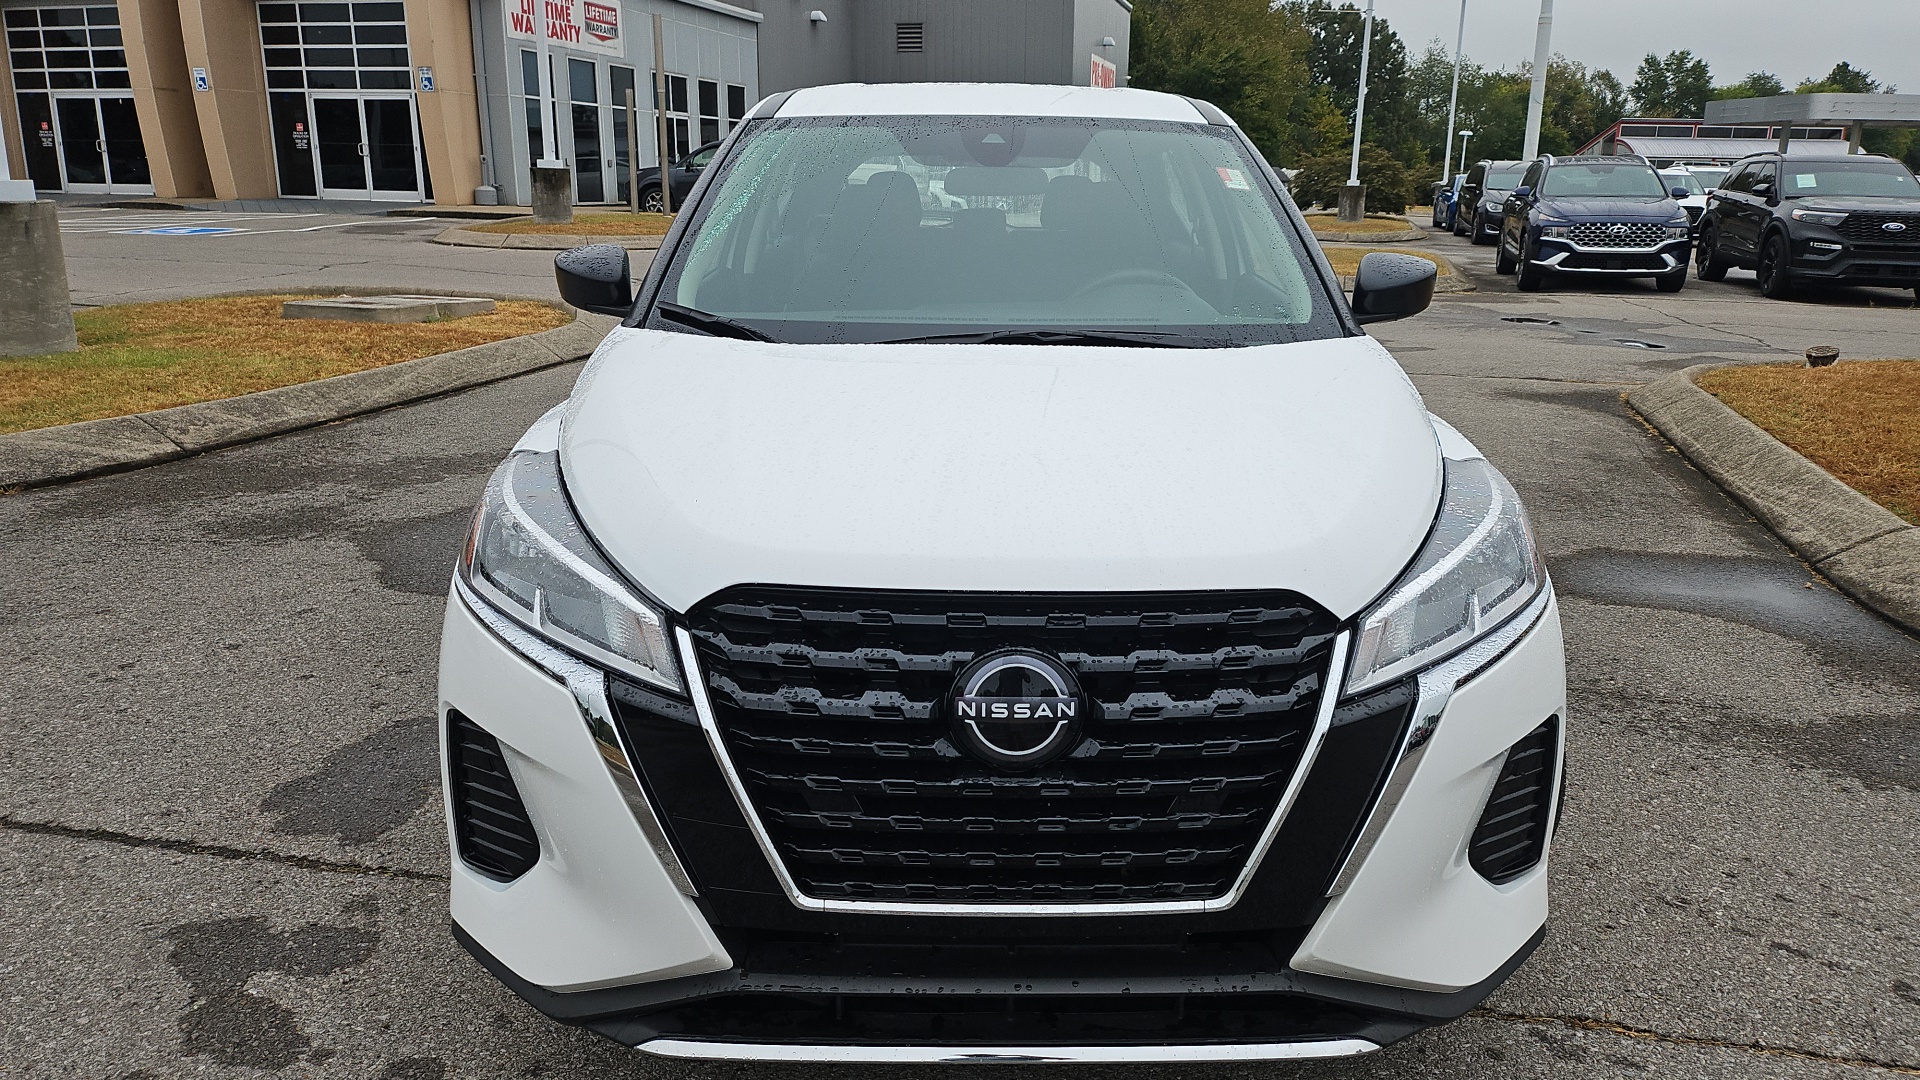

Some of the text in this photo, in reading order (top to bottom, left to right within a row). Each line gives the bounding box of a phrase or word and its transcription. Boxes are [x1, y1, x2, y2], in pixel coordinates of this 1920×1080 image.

[520, 0, 572, 24] LITIME
[585, 5, 617, 24] LIFETIME
[511, 12, 581, 43] WARANTY
[586, 22, 618, 37] WARRANTY
[958, 700, 1075, 719] NISSAN
